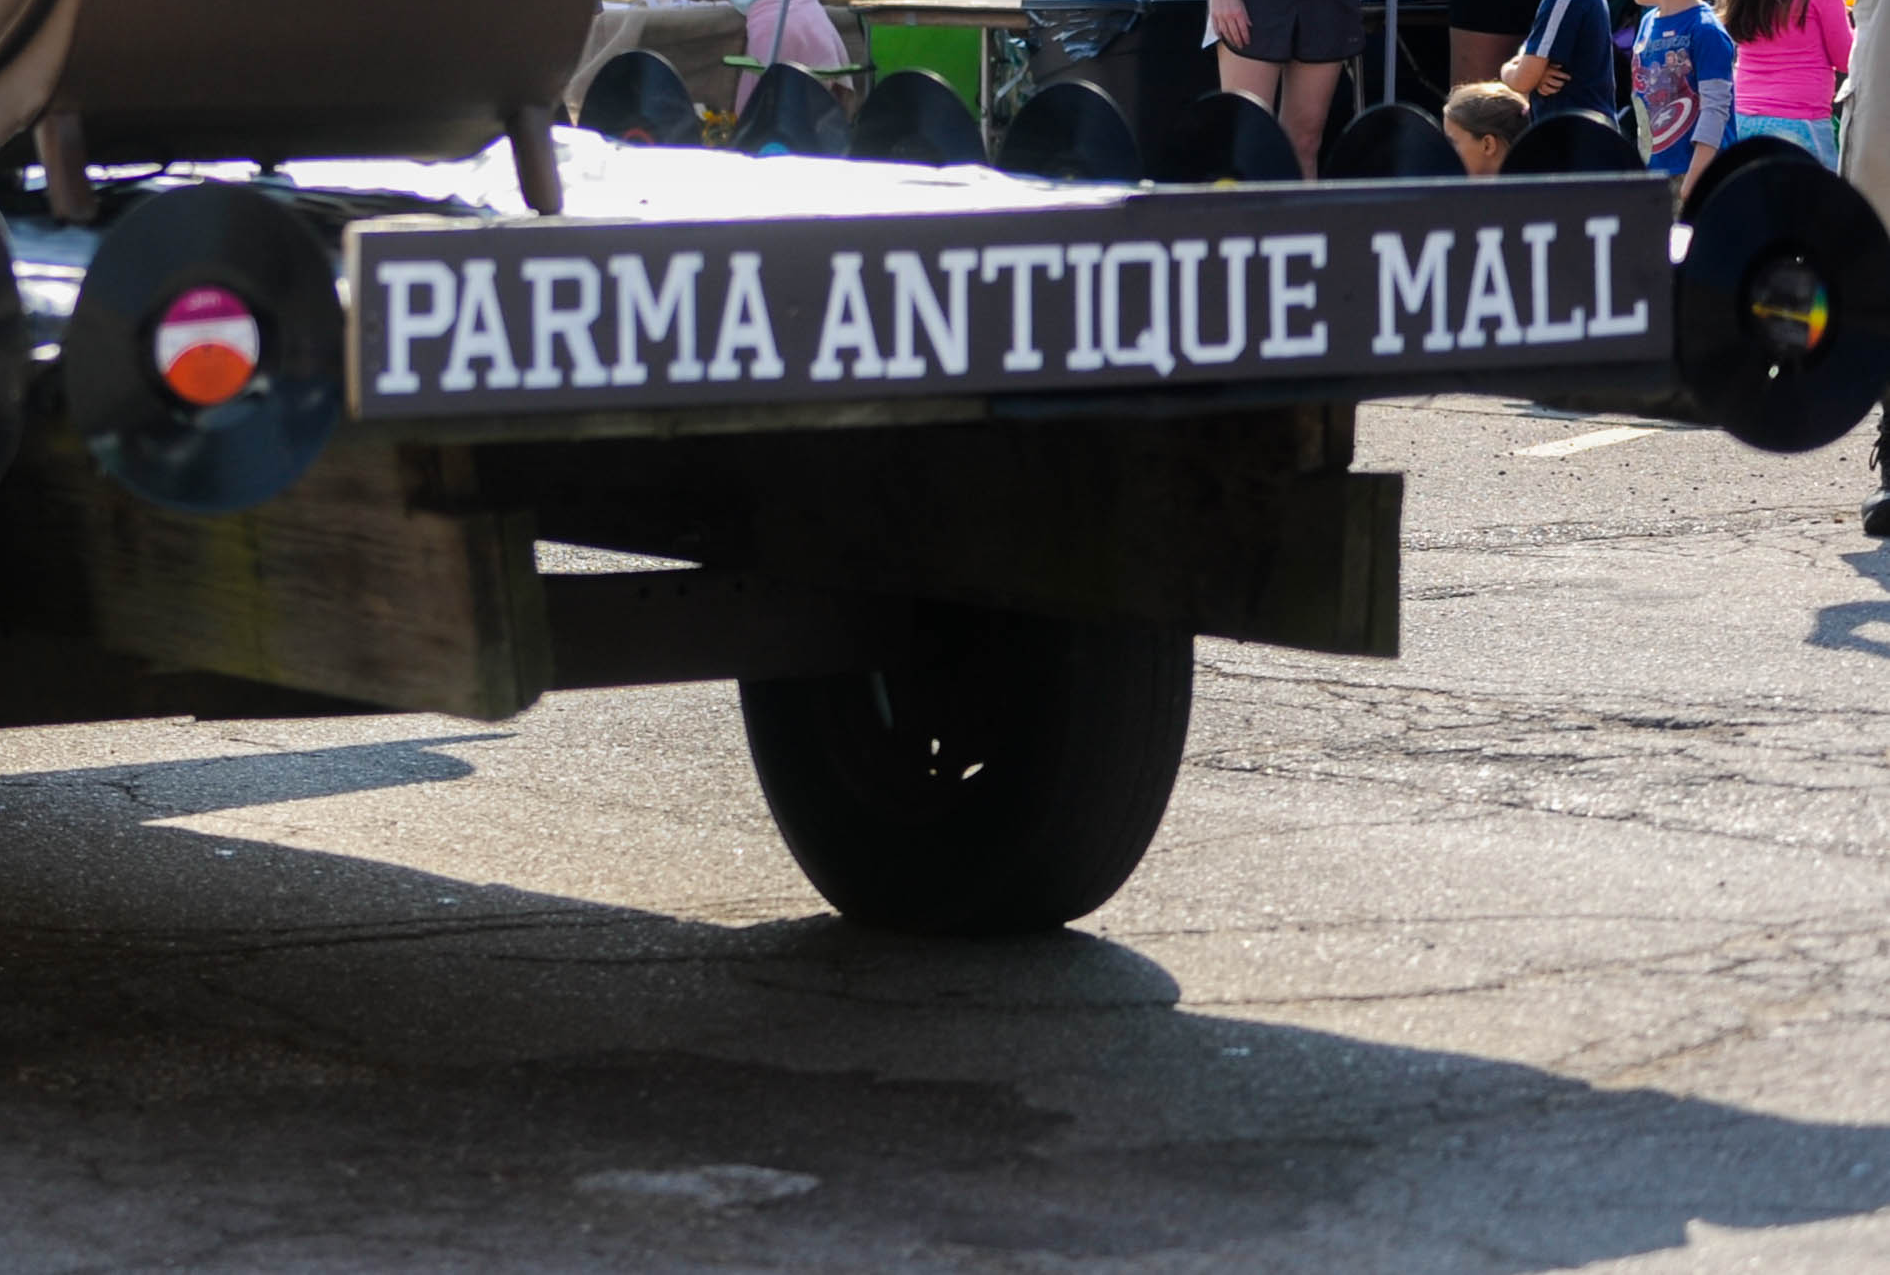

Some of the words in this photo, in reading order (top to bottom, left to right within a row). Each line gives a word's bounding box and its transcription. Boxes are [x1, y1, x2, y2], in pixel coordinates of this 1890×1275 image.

[376, 252, 784, 394] PARMA
[810, 234, 1328, 380] ANTIQUE
[1371, 216, 1649, 355] MALL
